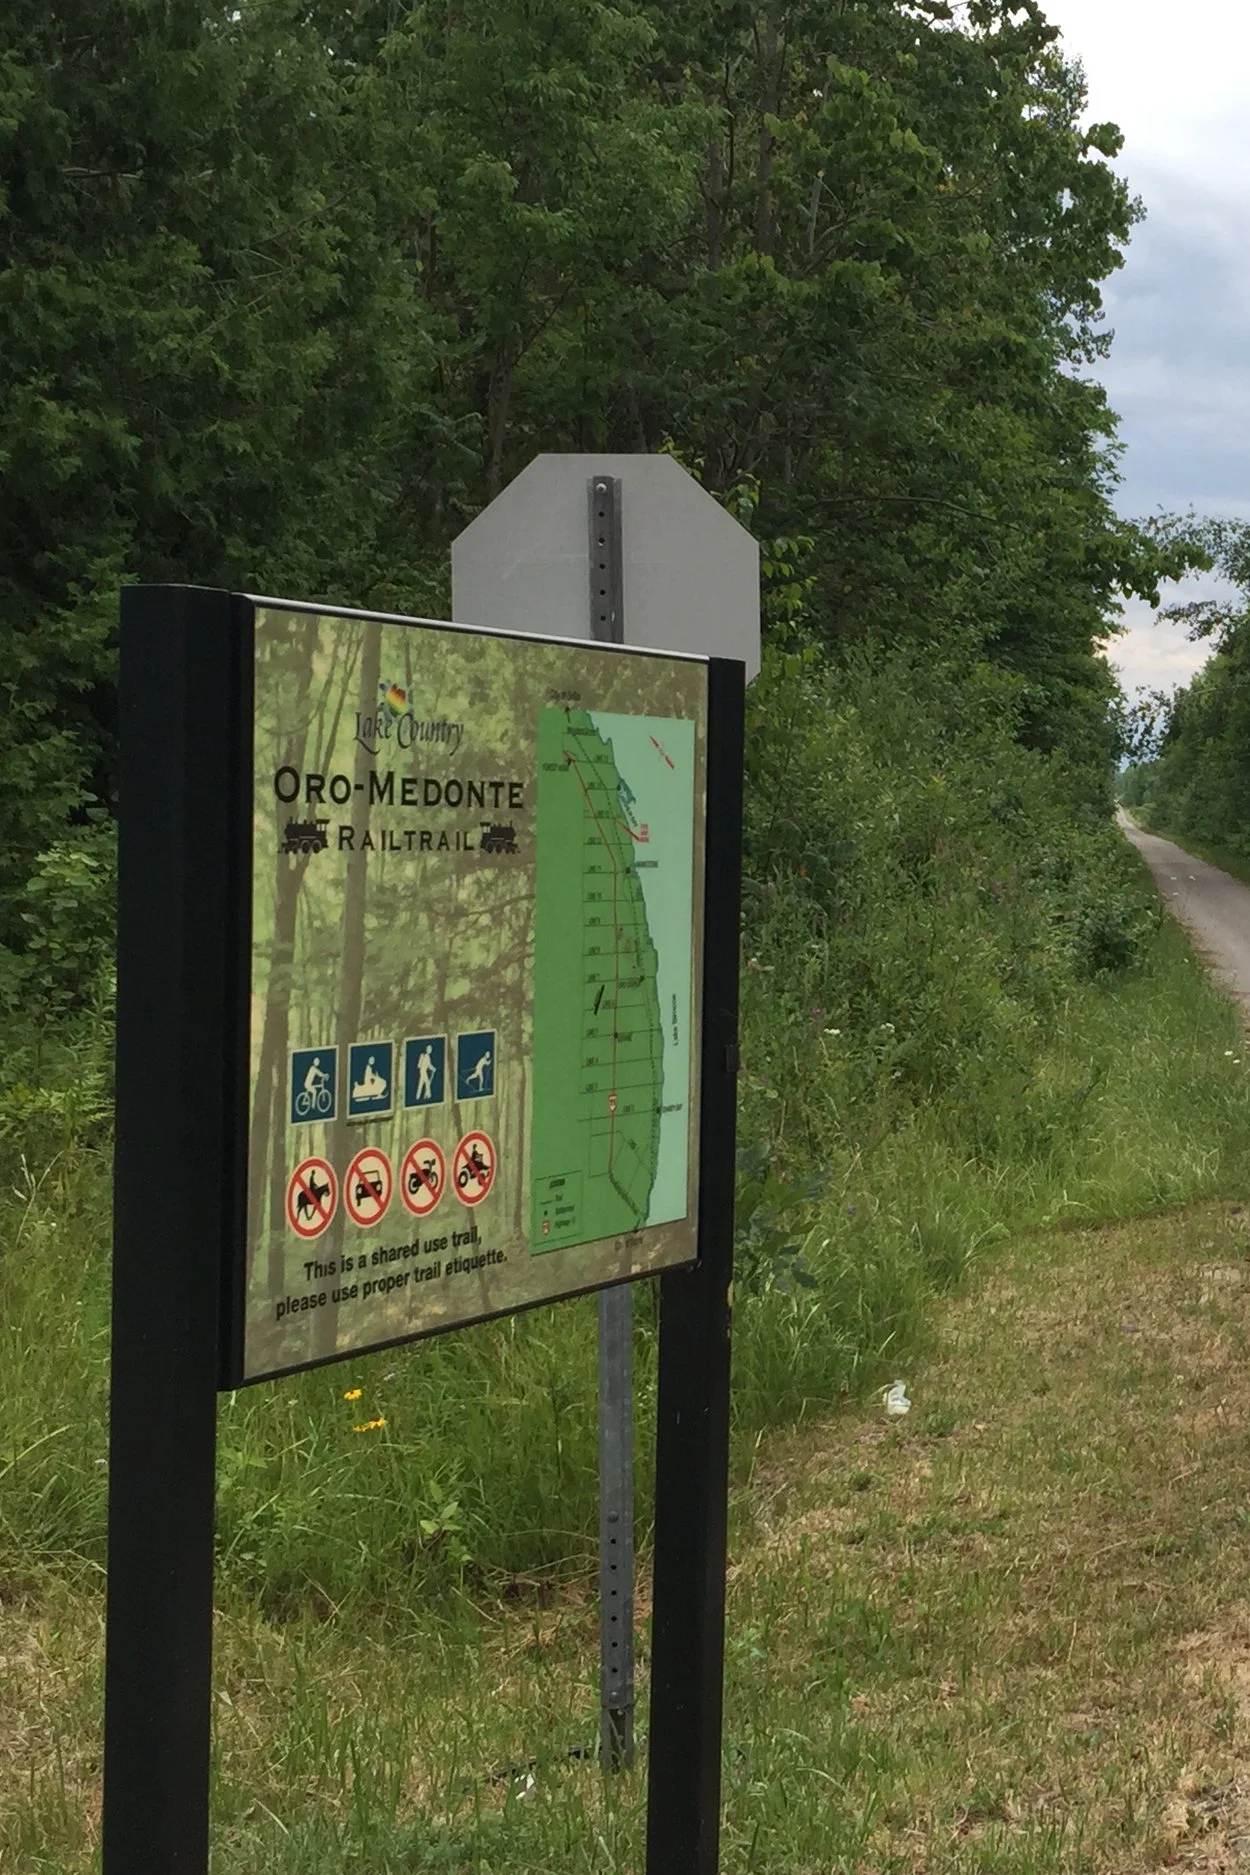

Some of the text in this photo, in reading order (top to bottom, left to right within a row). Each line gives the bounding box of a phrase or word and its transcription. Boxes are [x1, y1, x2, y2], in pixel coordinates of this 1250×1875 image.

[353, 711, 464, 756] Lake Country
[274, 766, 524, 809] ORO-MEDONTE
[338, 825, 475, 852] RAILTRAIL
[303, 1226, 482, 1281] This is a shared use trail,
[275, 1249, 508, 1320] please use proper trail etiquette.
